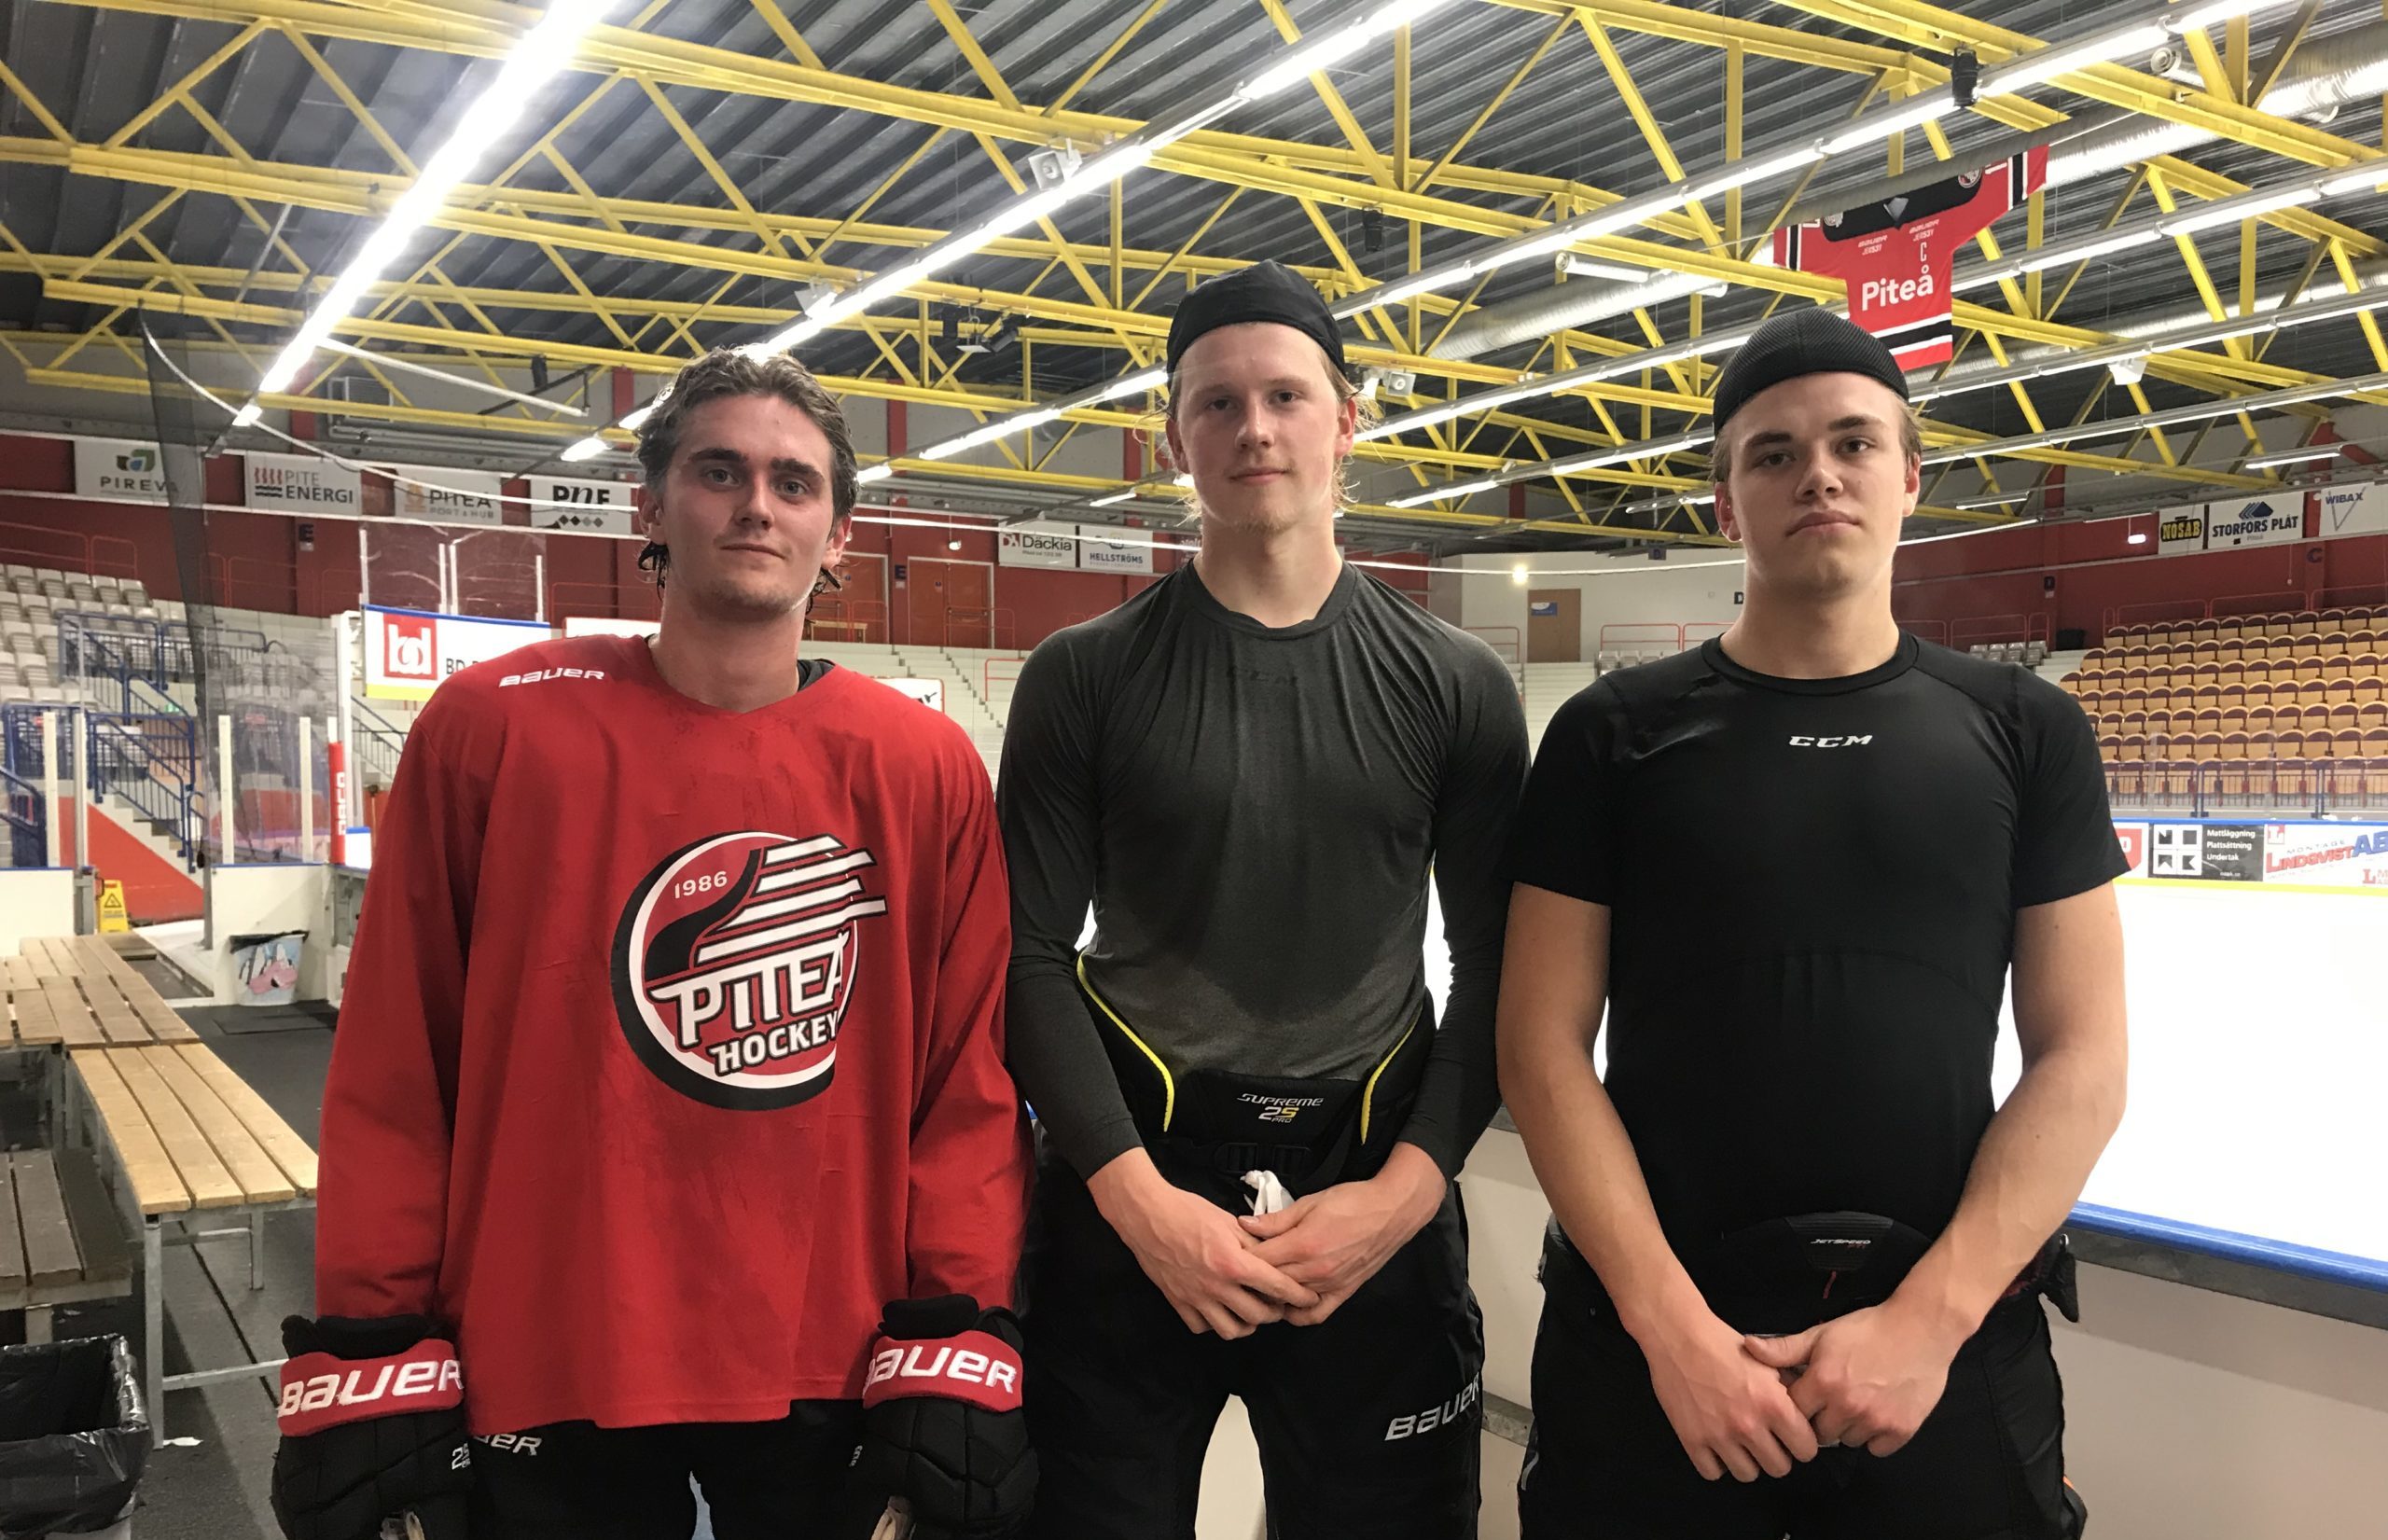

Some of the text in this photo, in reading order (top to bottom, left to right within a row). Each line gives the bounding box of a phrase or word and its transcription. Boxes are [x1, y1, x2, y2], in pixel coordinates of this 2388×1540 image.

[1920, 241, 1927, 262] C
[1861, 264, 1935, 312] Piteå
[100, 476, 179, 493] PIREVA
[285, 469, 321, 486] PITE
[285, 485, 354, 504] ENERGI
[2326, 492, 2364, 505] WIBAX
[2161, 520, 2201, 541] NOSAB
[2212, 514, 2299, 538] STORFORS PLÅT
[1022, 534, 1073, 551] Däckia
[1089, 552, 1144, 564] HELLSTRÖMS
[1788, 734, 1873, 748] CCM
[2206, 828, 2256, 839] Mattläggning
[2206, 840, 2253, 850] Plattsättning
[2286, 839, 2346, 854] MONTAGE
[2206, 853, 2240, 861] Undertak
[673, 870, 729, 899] 1986
[708, 1009, 840, 1074] HOCKEY
[1236, 1092, 1324, 1107] SUPREME
[1257, 1106, 1299, 1121] 2S
[277, 1359, 465, 1419] BAUER
